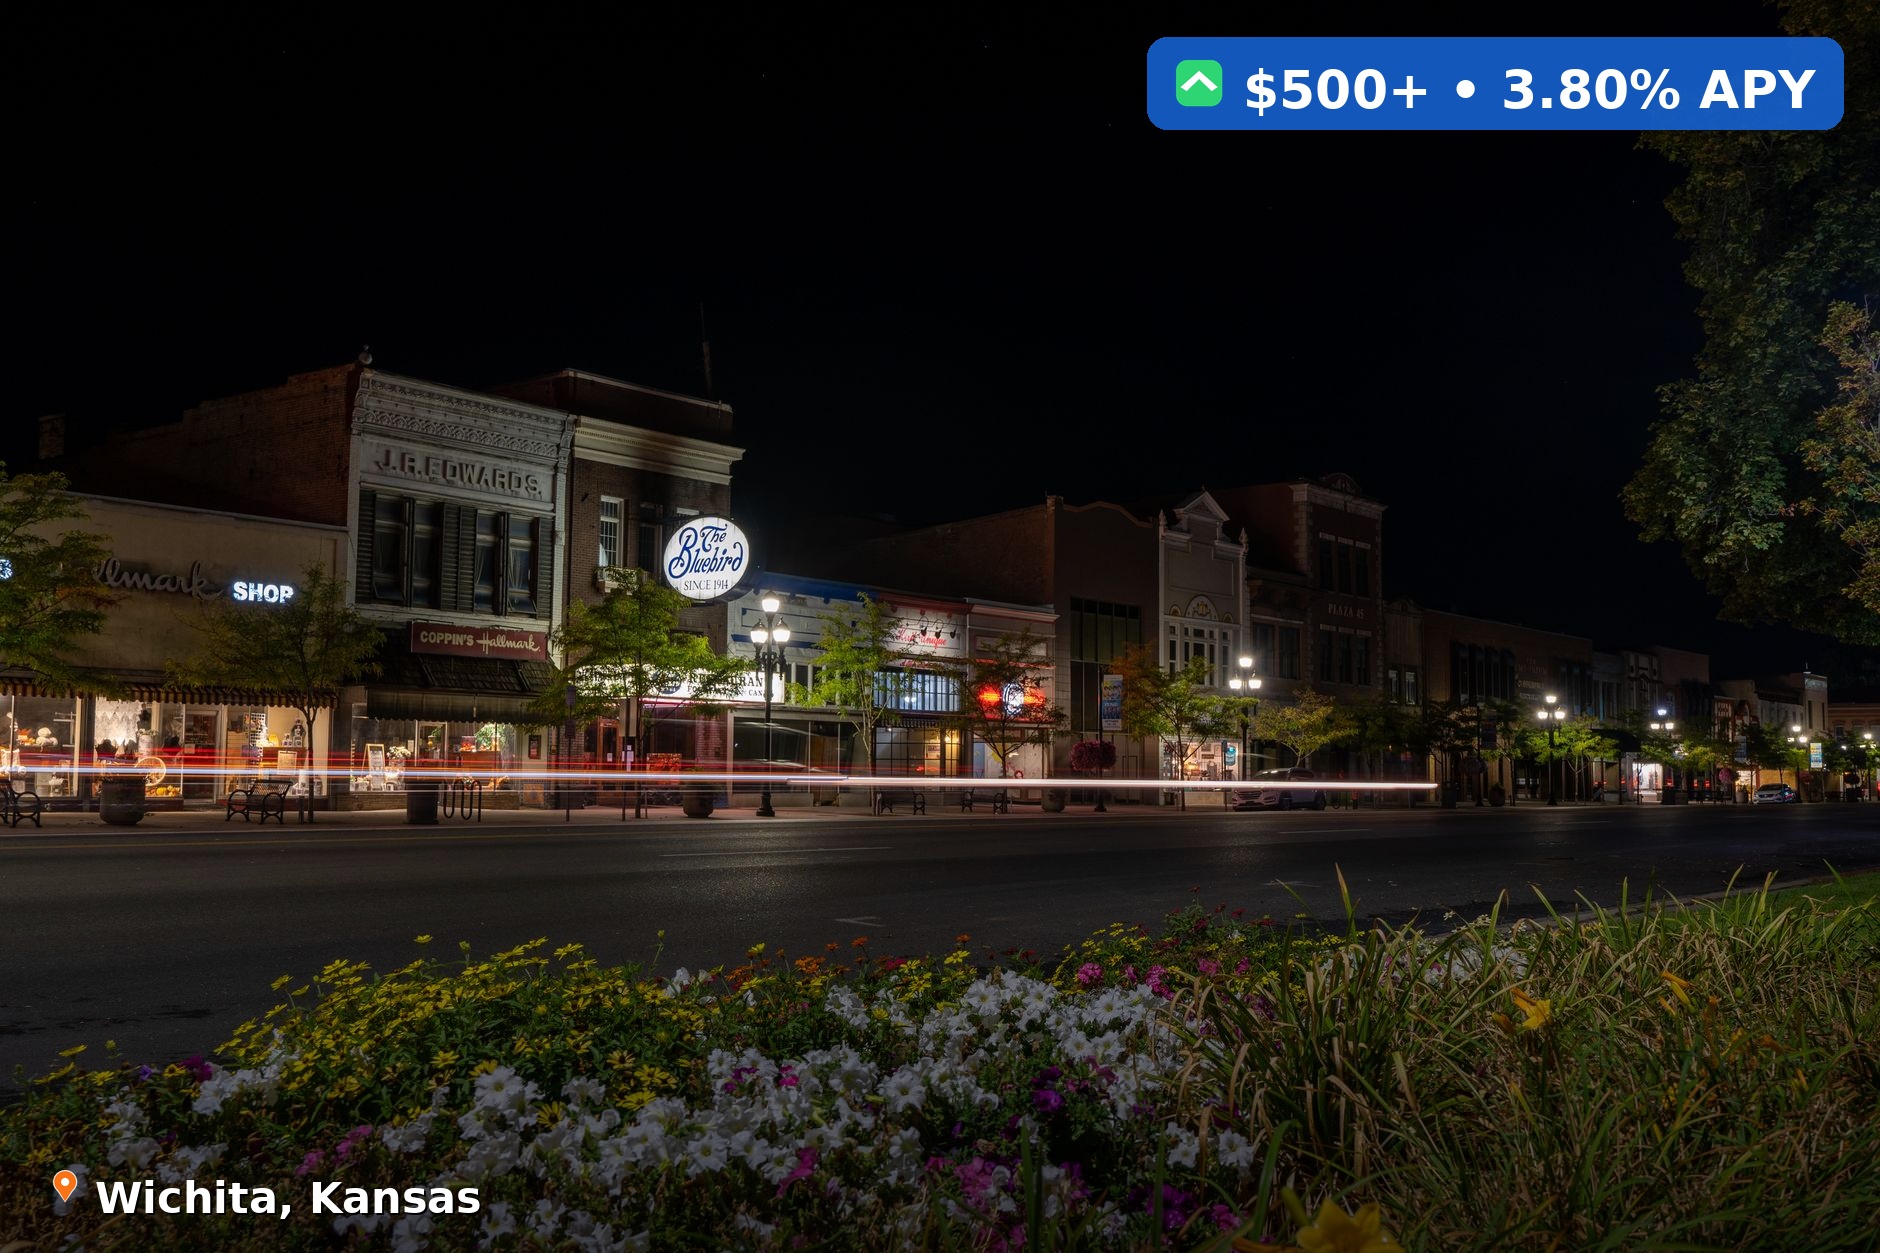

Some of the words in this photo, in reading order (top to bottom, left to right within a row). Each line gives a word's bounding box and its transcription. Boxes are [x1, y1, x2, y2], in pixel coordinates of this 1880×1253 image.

[700, 523, 728, 552] The
[668, 526, 744, 579] Bluebird
[233, 581, 294, 604] SHOP
[684, 580, 712, 592] SINCE
[713, 579, 729, 590] 1914
[420, 630, 476, 647] COPPIN'S
